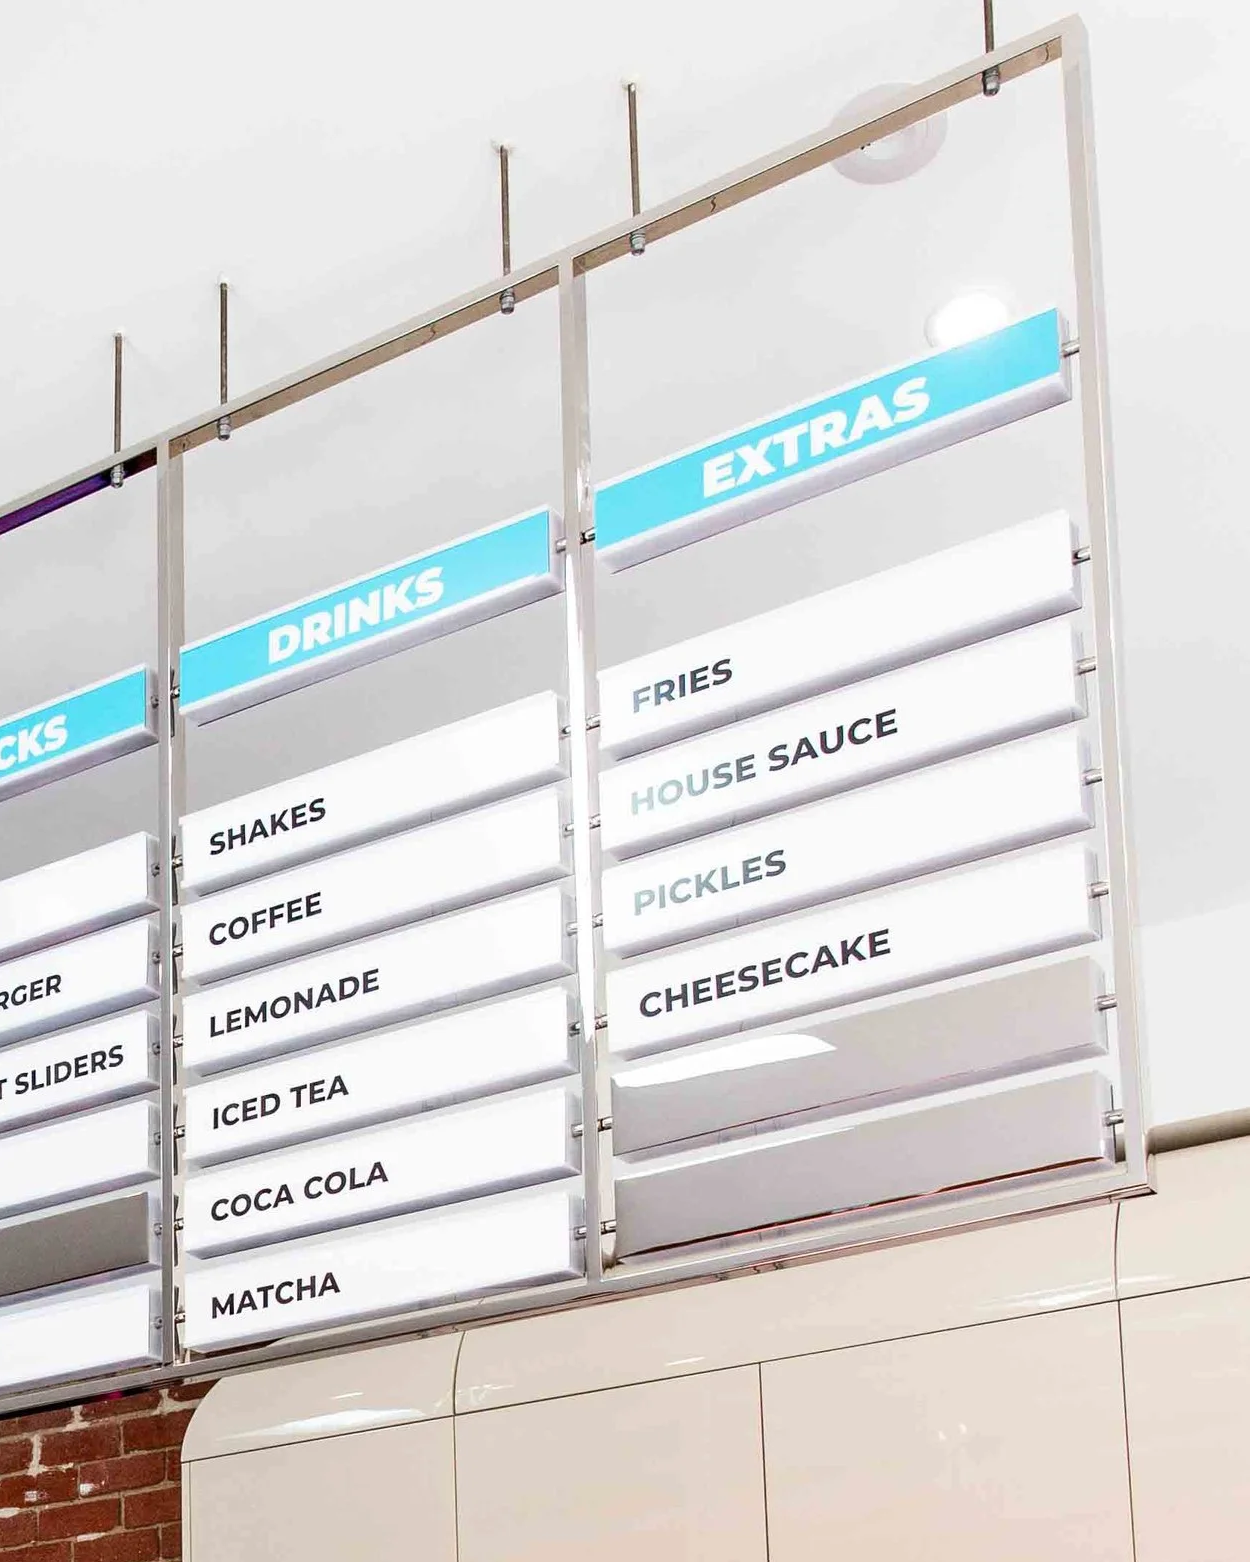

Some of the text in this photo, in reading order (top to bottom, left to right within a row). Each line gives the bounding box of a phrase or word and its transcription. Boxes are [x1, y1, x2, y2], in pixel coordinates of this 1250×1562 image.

[704, 377, 930, 497] EXTRAS
[269, 567, 443, 663] DRINKS
[634, 659, 732, 712] FRIES
[630, 709, 897, 817] HOUSE SAUCE
[210, 798, 325, 855] SHAKES
[636, 850, 786, 915] PICKLES
[209, 892, 322, 945] COFFEE
[210, 968, 379, 1037] LEMONADE
[640, 929, 890, 1017] CHEESECAKE
[15, 1045, 123, 1094] SLIDERS
[213, 1075, 349, 1129] ICED TEA
[211, 1162, 388, 1221] COCA COLA
[212, 1272, 340, 1319] MATCHA
